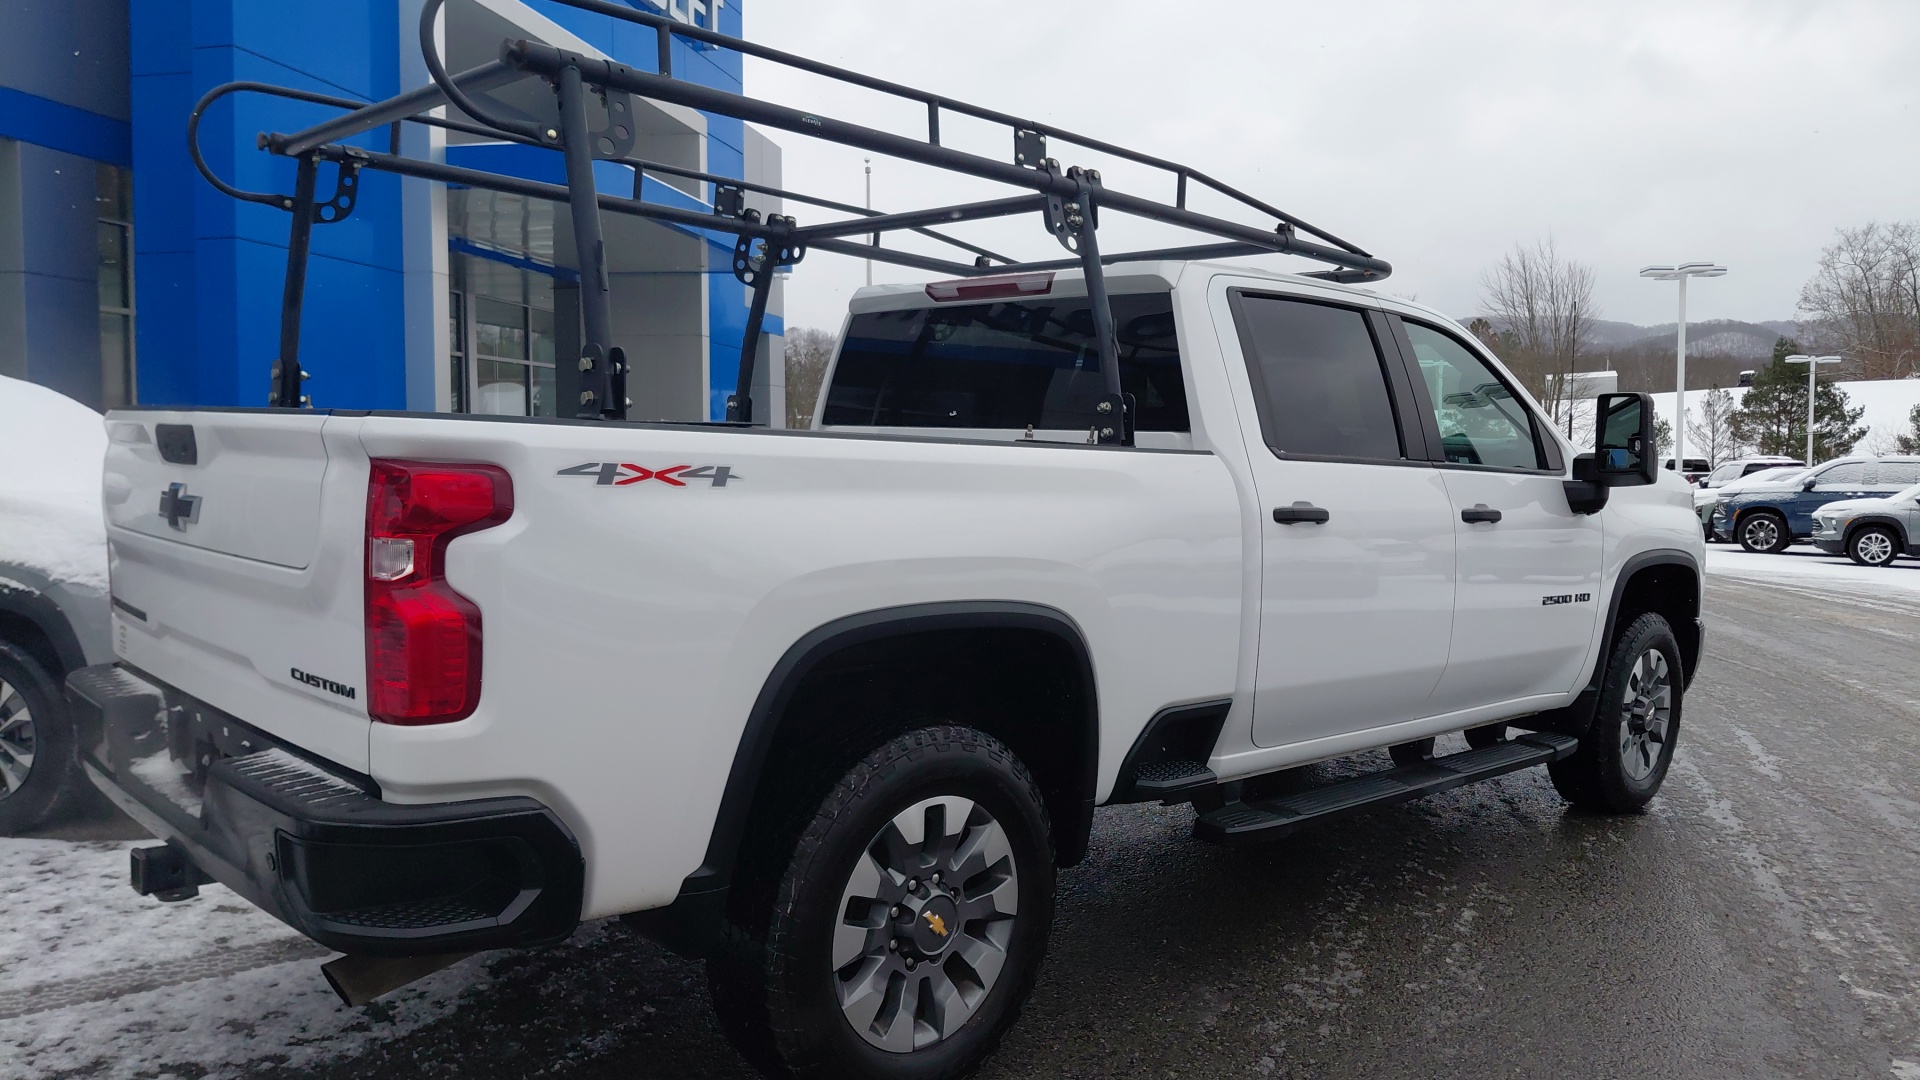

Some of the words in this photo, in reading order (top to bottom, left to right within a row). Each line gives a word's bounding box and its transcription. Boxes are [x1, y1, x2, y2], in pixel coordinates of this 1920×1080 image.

[1542, 594, 1573, 606] 2500
[1574, 592, 1591, 603] HD
[290, 667, 356, 700] CUSTOM
